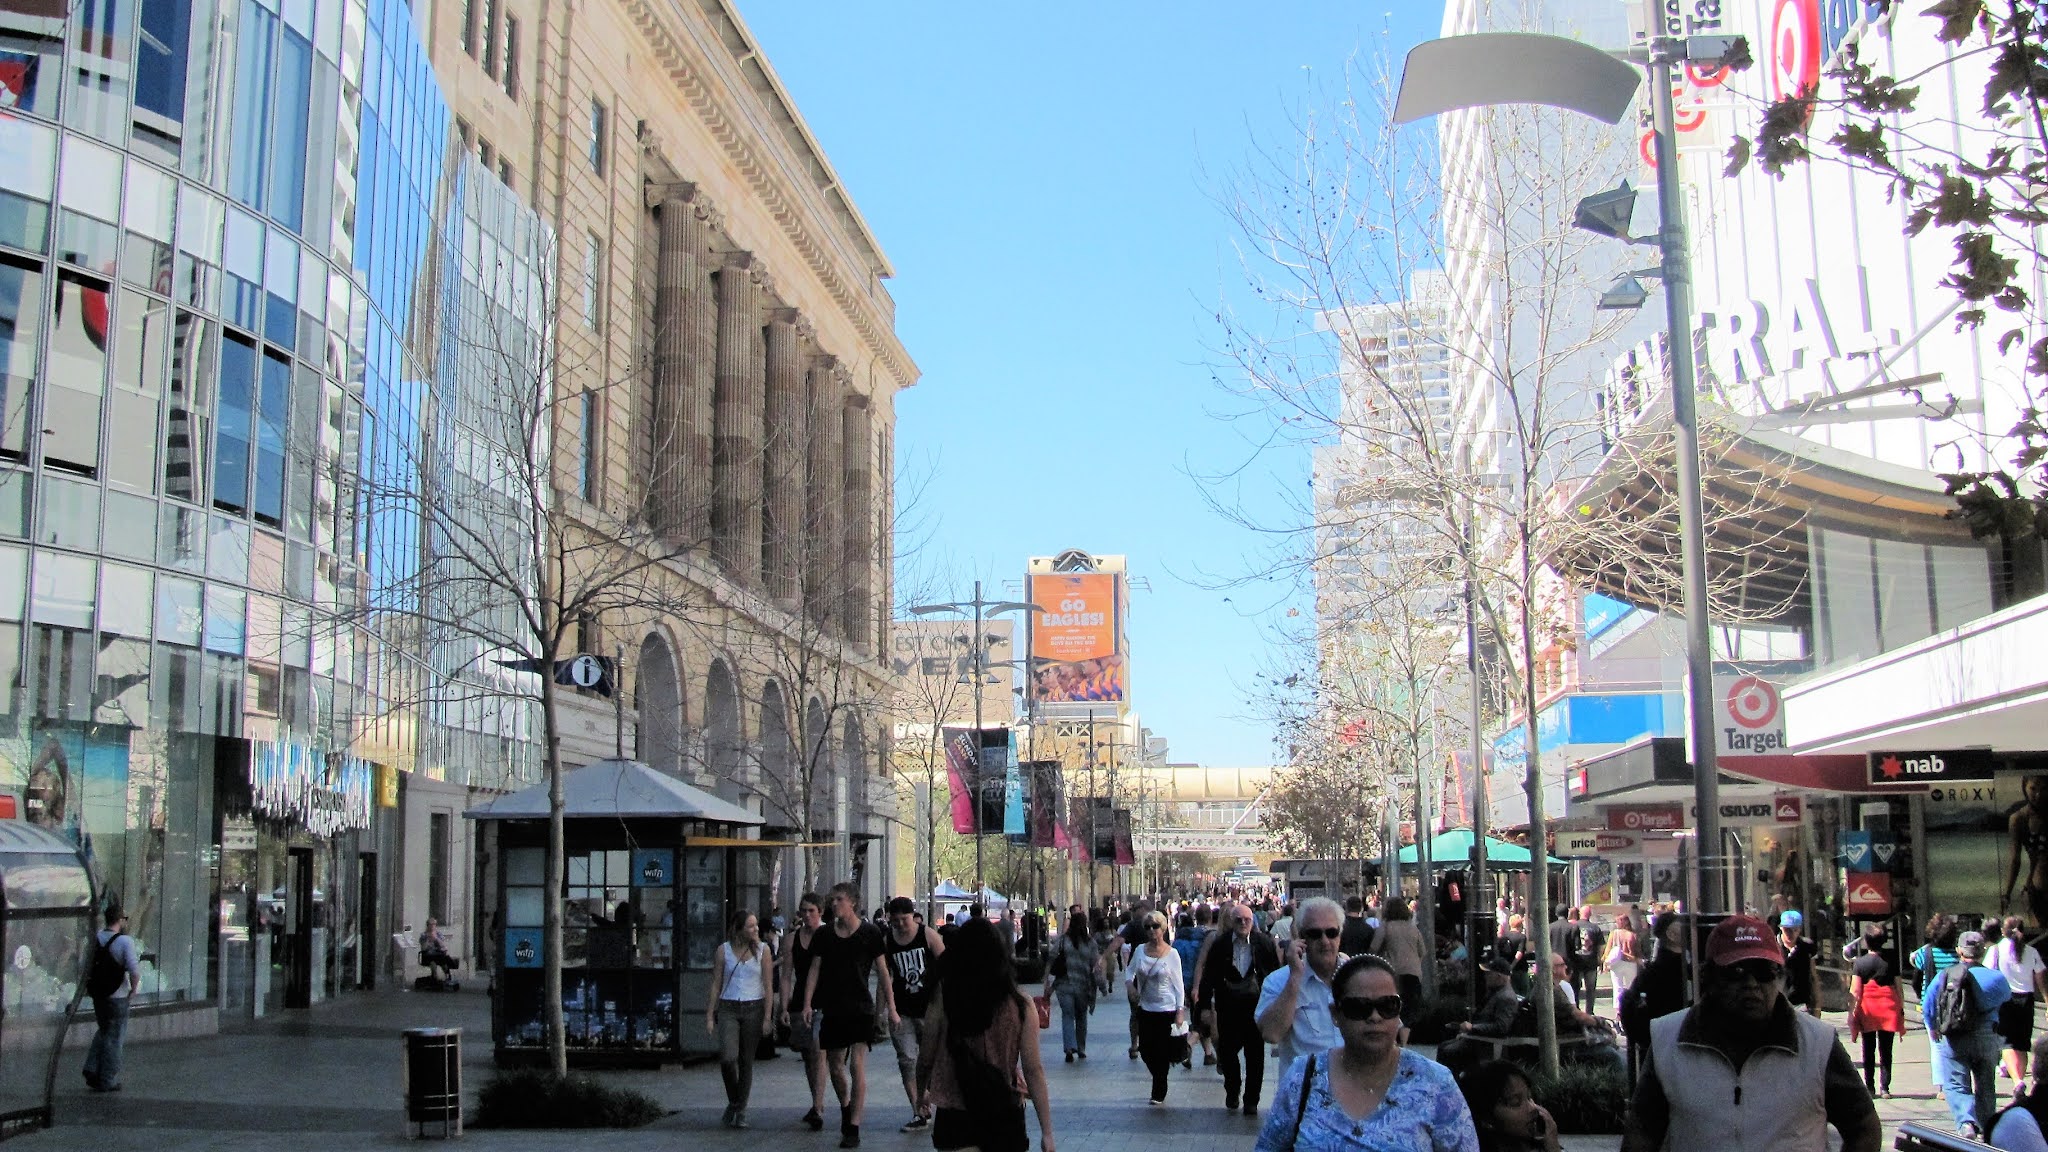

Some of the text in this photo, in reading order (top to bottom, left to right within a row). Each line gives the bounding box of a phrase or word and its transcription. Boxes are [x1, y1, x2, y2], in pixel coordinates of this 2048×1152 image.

[1060, 599, 1086, 611] GO
[1042, 612, 1104, 627] EAGLES!
[1724, 727, 1785, 753] Target
[957, 733, 979, 766] SUNDAY
[1905, 755, 1944, 773] nab
[1949, 787, 1995, 801] ROXY
[1571, 838, 1595, 850] price
